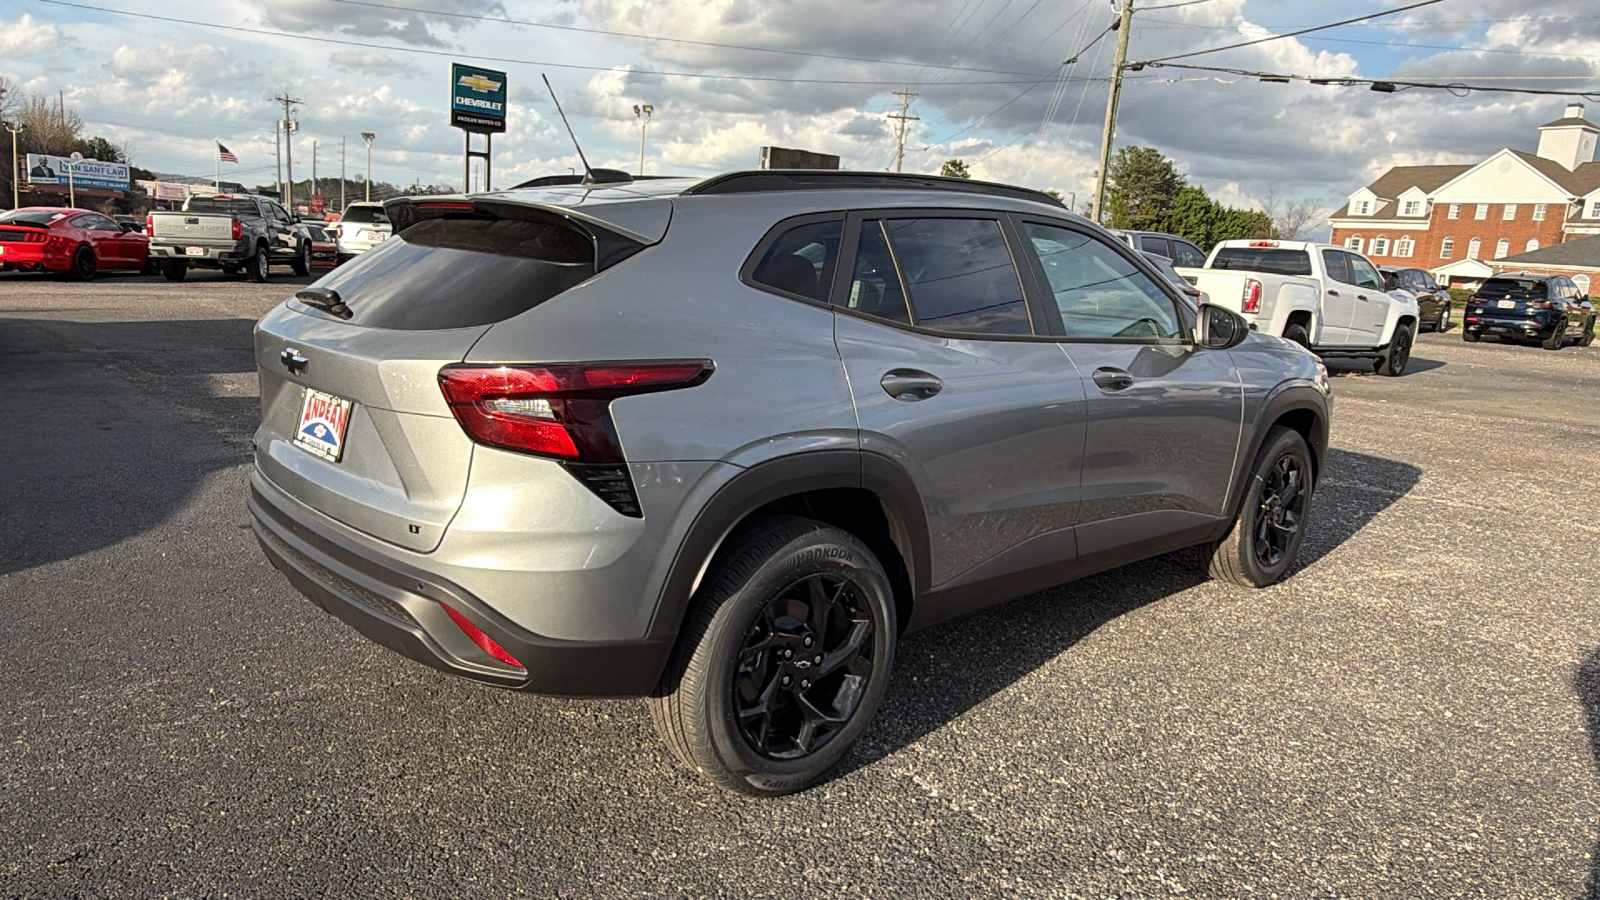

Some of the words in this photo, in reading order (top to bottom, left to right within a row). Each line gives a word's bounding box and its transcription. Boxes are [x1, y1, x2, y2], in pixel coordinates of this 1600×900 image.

[456, 96, 502, 110] CHEVROLET
[63, 164, 81, 172] VAN
[82, 165, 105, 174] SANT
[107, 167, 125, 176] LAW
[302, 396, 348, 440] ANDEAN
[409, 524, 421, 534] LT
